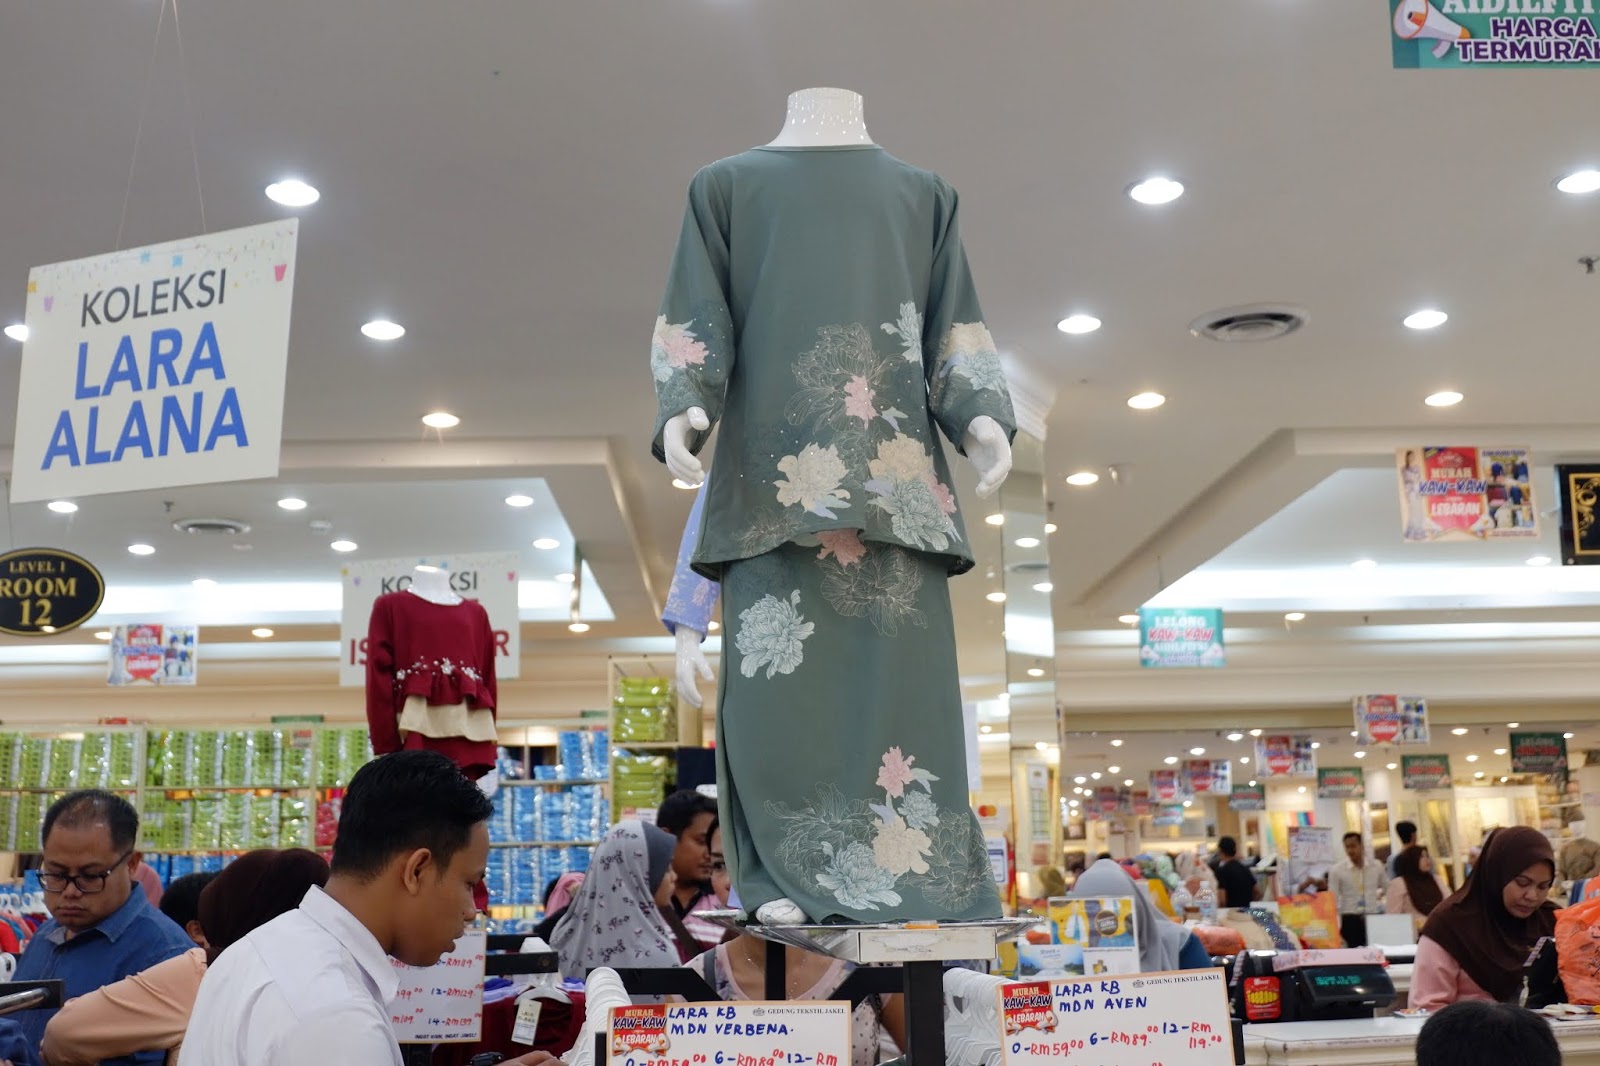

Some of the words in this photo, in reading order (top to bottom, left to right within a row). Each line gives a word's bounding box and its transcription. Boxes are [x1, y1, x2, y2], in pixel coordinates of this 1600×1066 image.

[1491, 17, 1596, 38] HARGA
[81, 268, 227, 328] KOLEKSI
[75, 321, 226, 401] LARA
[40, 386, 249, 471] ALANA
[1418, 478, 1488, 496] KAW-KAW
[9, 561, 55, 573] LEVEL
[0, 577, 78, 598] ROOM
[20, 598, 52, 626] 12
[1146, 978, 1173, 986] GEDUNG
[1174, 976, 1200, 984] TEKSTIL
[1200, 974, 1221, 982] JAKEL
[1012, 987, 1039, 996] MURAH
[1055, 983, 1092, 997] LARA
[1101, 980, 1120, 995] KB
[1003, 994, 1053, 1010] KAW-KAW
[1104, 997, 1147, 1010] AVEN
[624, 1008, 655, 1017] MURAH
[668, 1007, 709, 1020] LARA
[716, 1006, 737, 1020] KB
[1013, 1011, 1045, 1024] LEBARAN
[613, 1016, 667, 1029] KAW-KAW
[671, 1023, 708, 1036] MDN
[622, 1033, 657, 1044] LEBARAN
